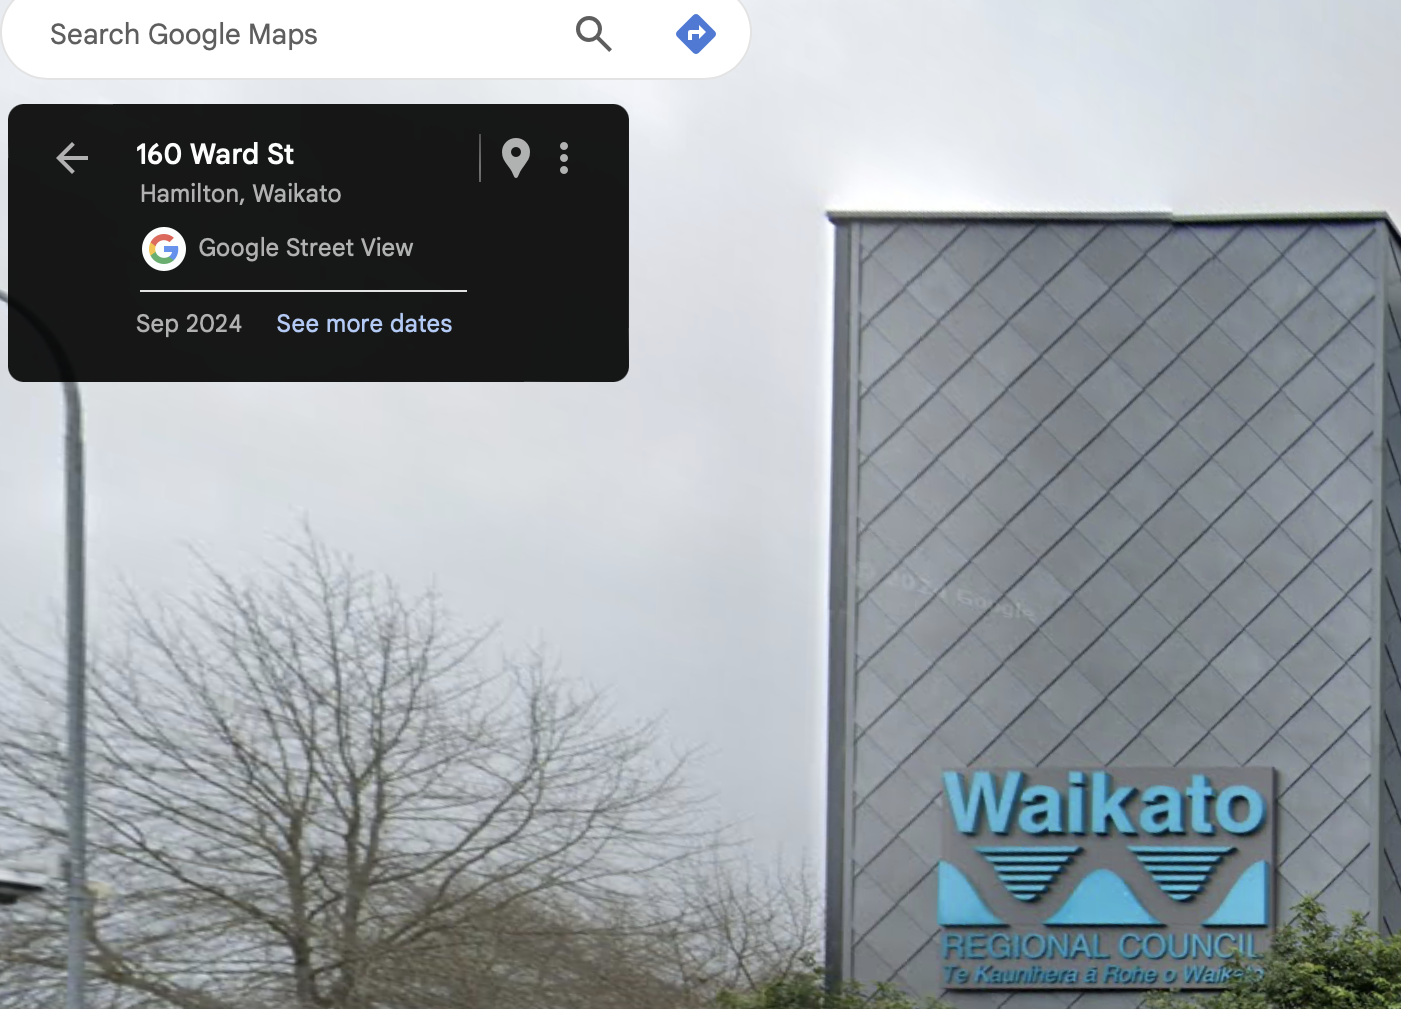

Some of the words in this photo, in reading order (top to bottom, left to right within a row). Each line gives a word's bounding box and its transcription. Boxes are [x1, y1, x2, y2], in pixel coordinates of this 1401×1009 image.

[943, 769, 1267, 835] Waikato
[941, 932, 1110, 960] REGIONAL
[1118, 932, 1264, 960] COUNCIL
[944, 965, 968, 984] Te
[974, 964, 1079, 984] Kaunihera
[1104, 963, 1158, 984] Rohe
[1162, 968, 1178, 984] o
